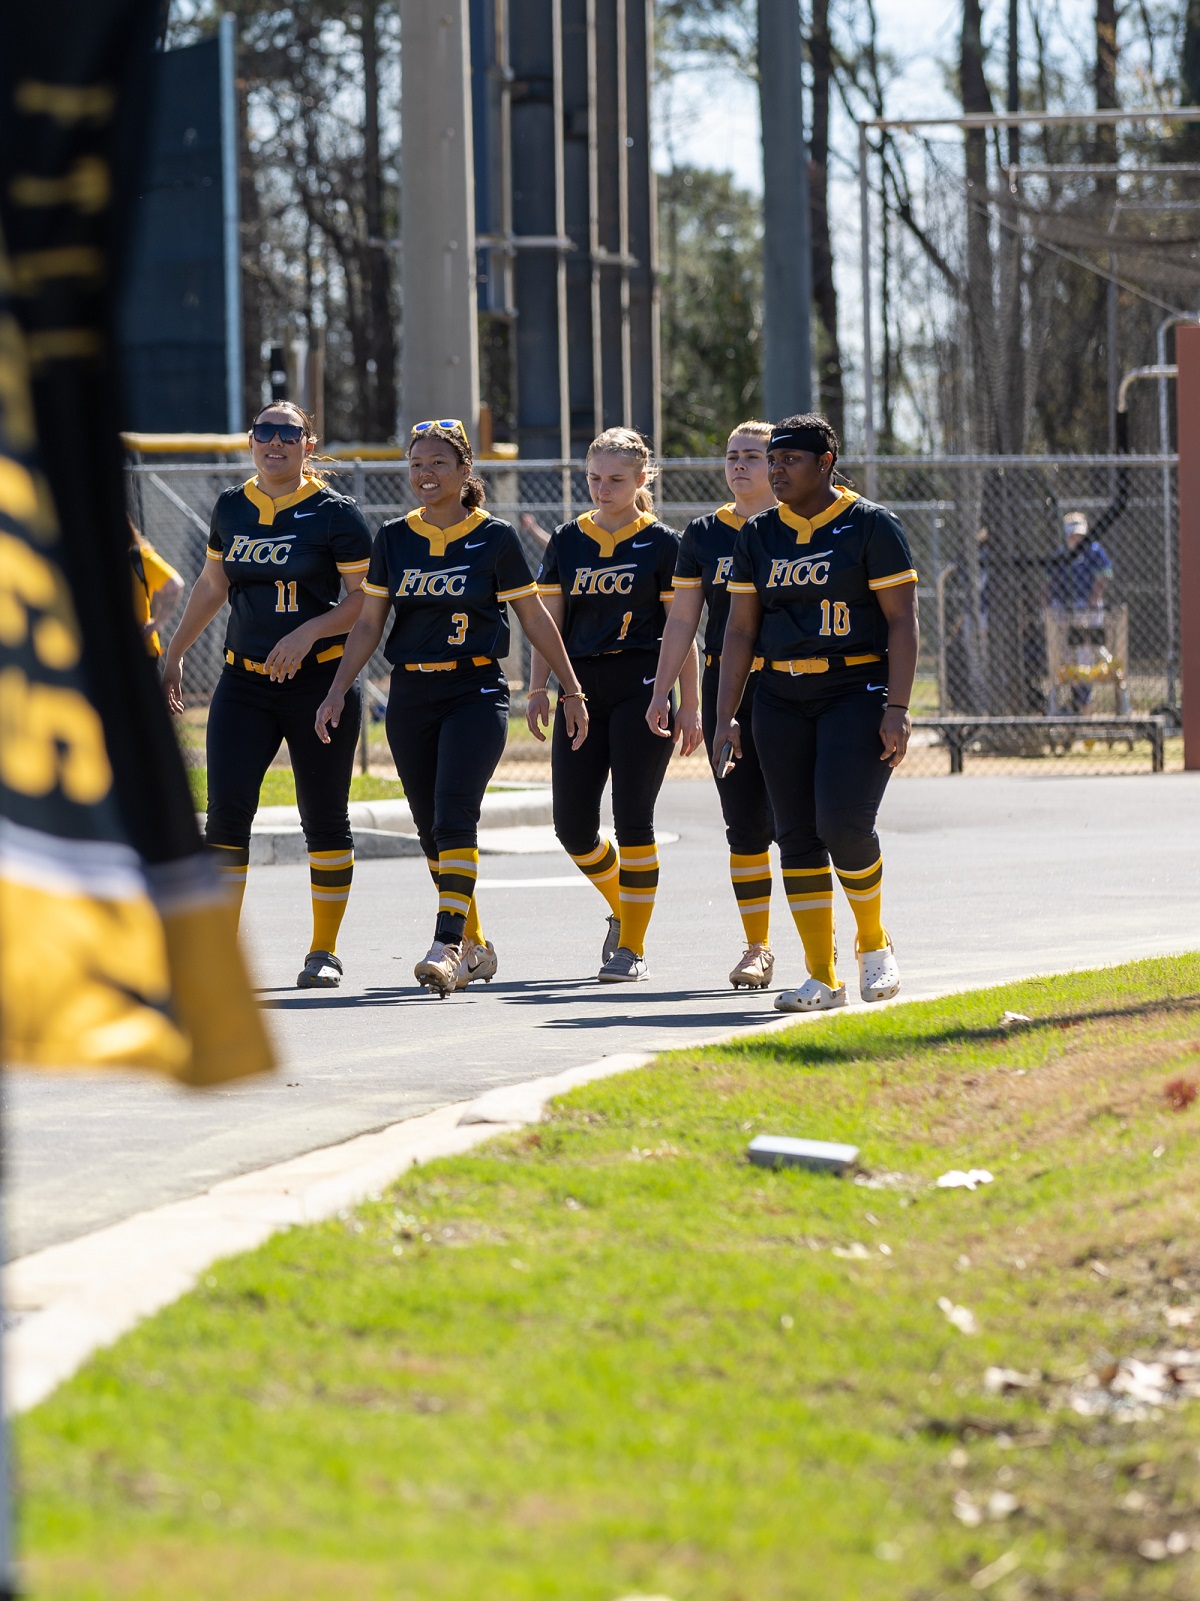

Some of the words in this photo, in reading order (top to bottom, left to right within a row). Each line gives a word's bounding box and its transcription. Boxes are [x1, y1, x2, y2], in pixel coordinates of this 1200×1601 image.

[225, 534, 297, 565] FTCC
[396, 565, 471, 597] FTCC
[570, 563, 638, 595] FTCC
[766, 550, 834, 588] FTCC
[275, 580, 299, 613] 11
[447, 613, 469, 645] 3
[818, 599, 851, 636] 10
